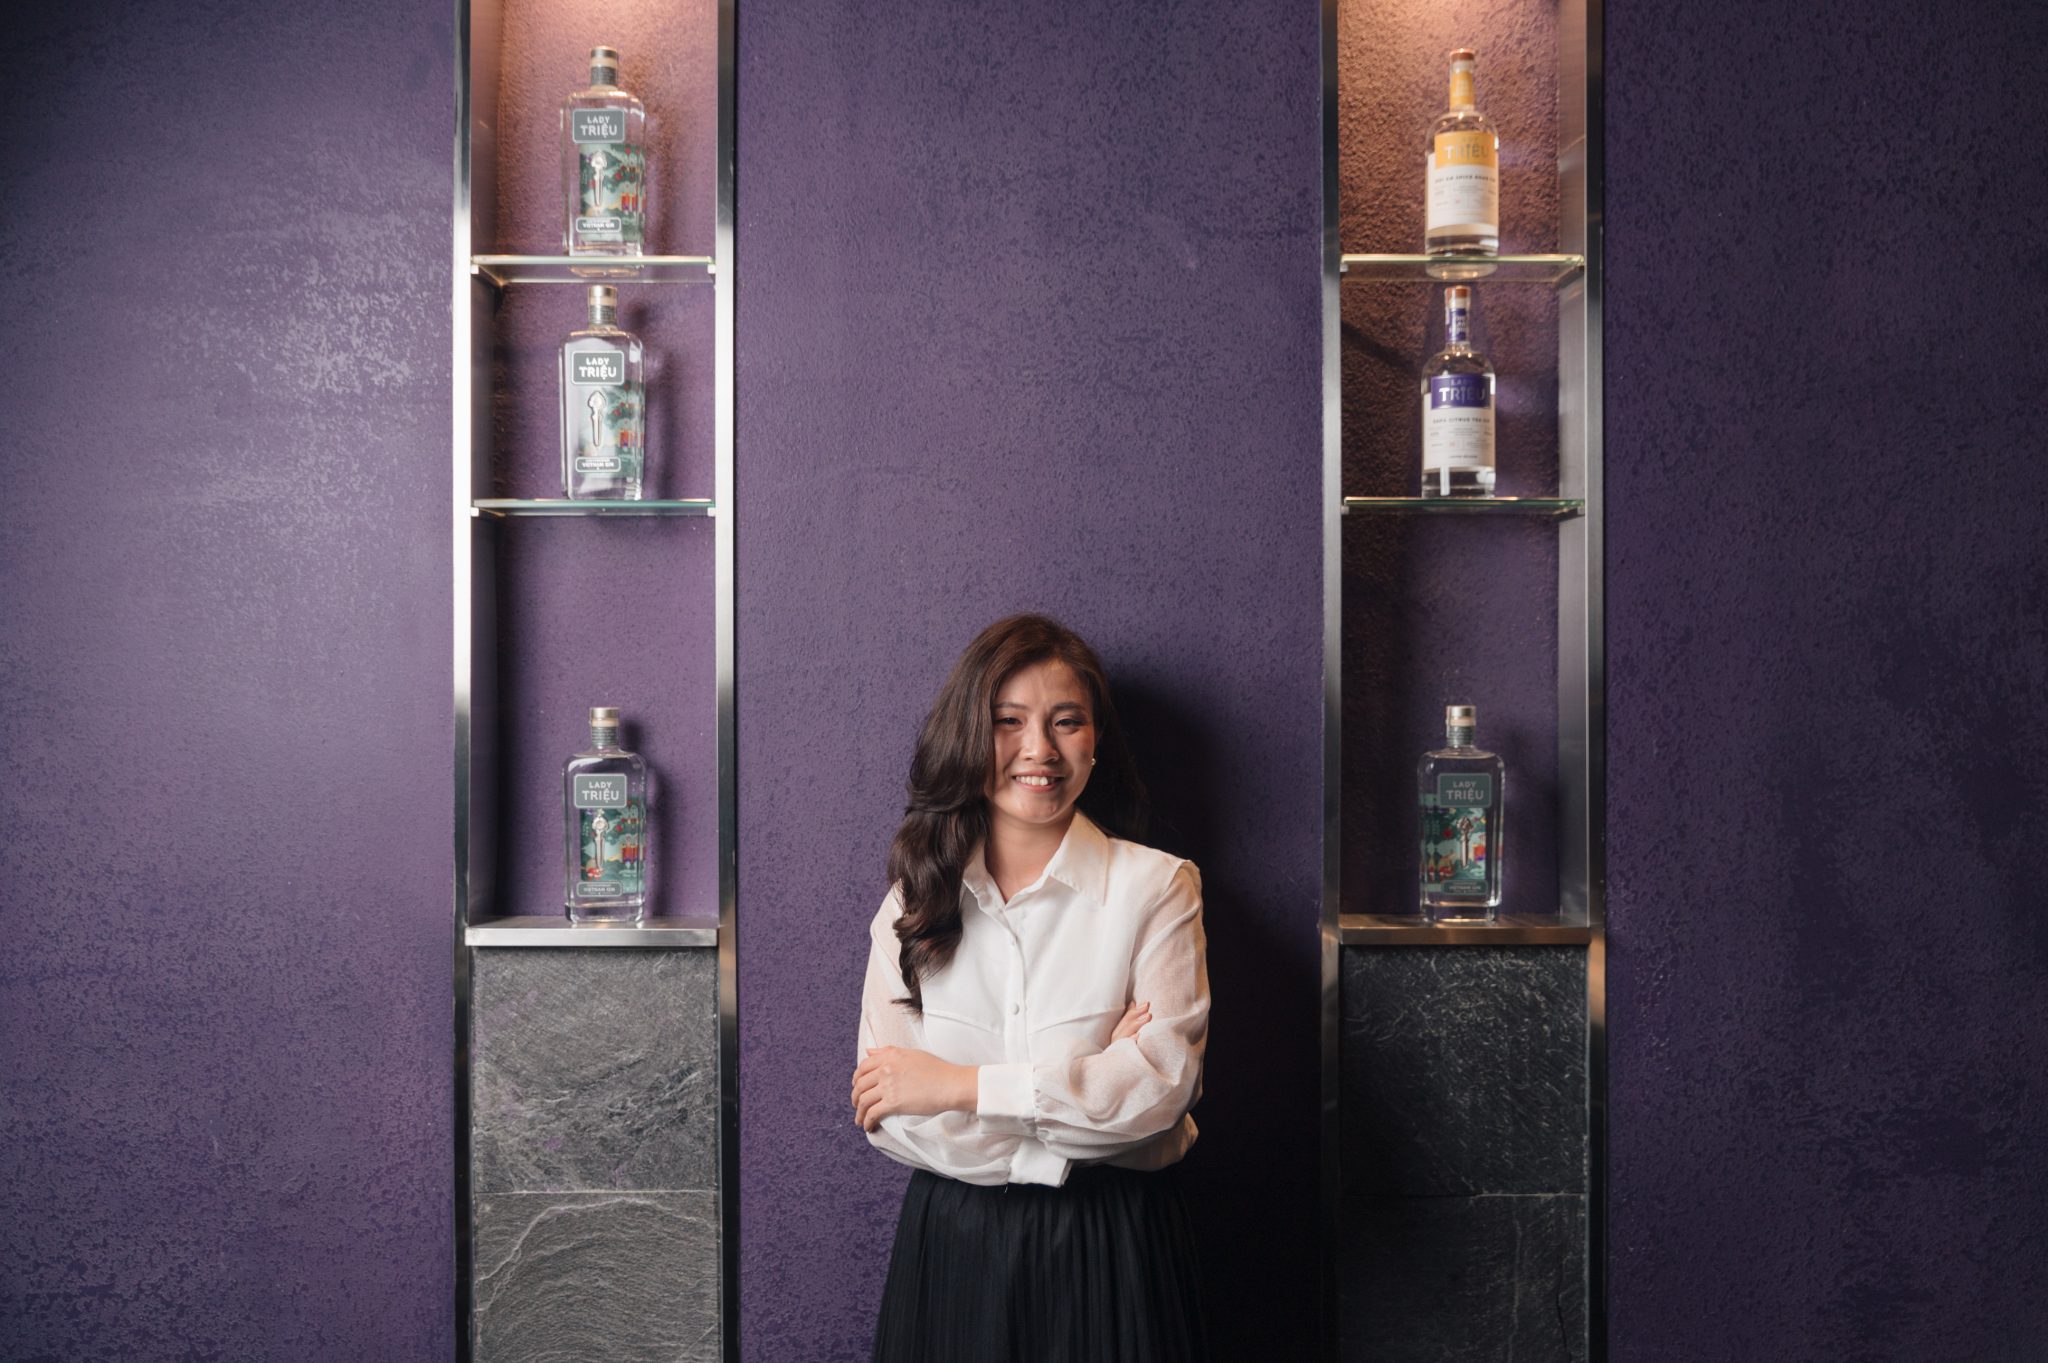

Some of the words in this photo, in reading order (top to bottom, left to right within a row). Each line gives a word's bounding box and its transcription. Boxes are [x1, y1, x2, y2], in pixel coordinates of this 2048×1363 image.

[587, 115, 610, 124] LADY
[580, 123, 618, 138] TRIỆU
[586, 357, 609, 365] LADY
[579, 364, 617, 380] TRIỆU
[588, 781, 612, 789] LADY
[1452, 780, 1477, 788] LADY
[582, 788, 620, 804] TRIỆU
